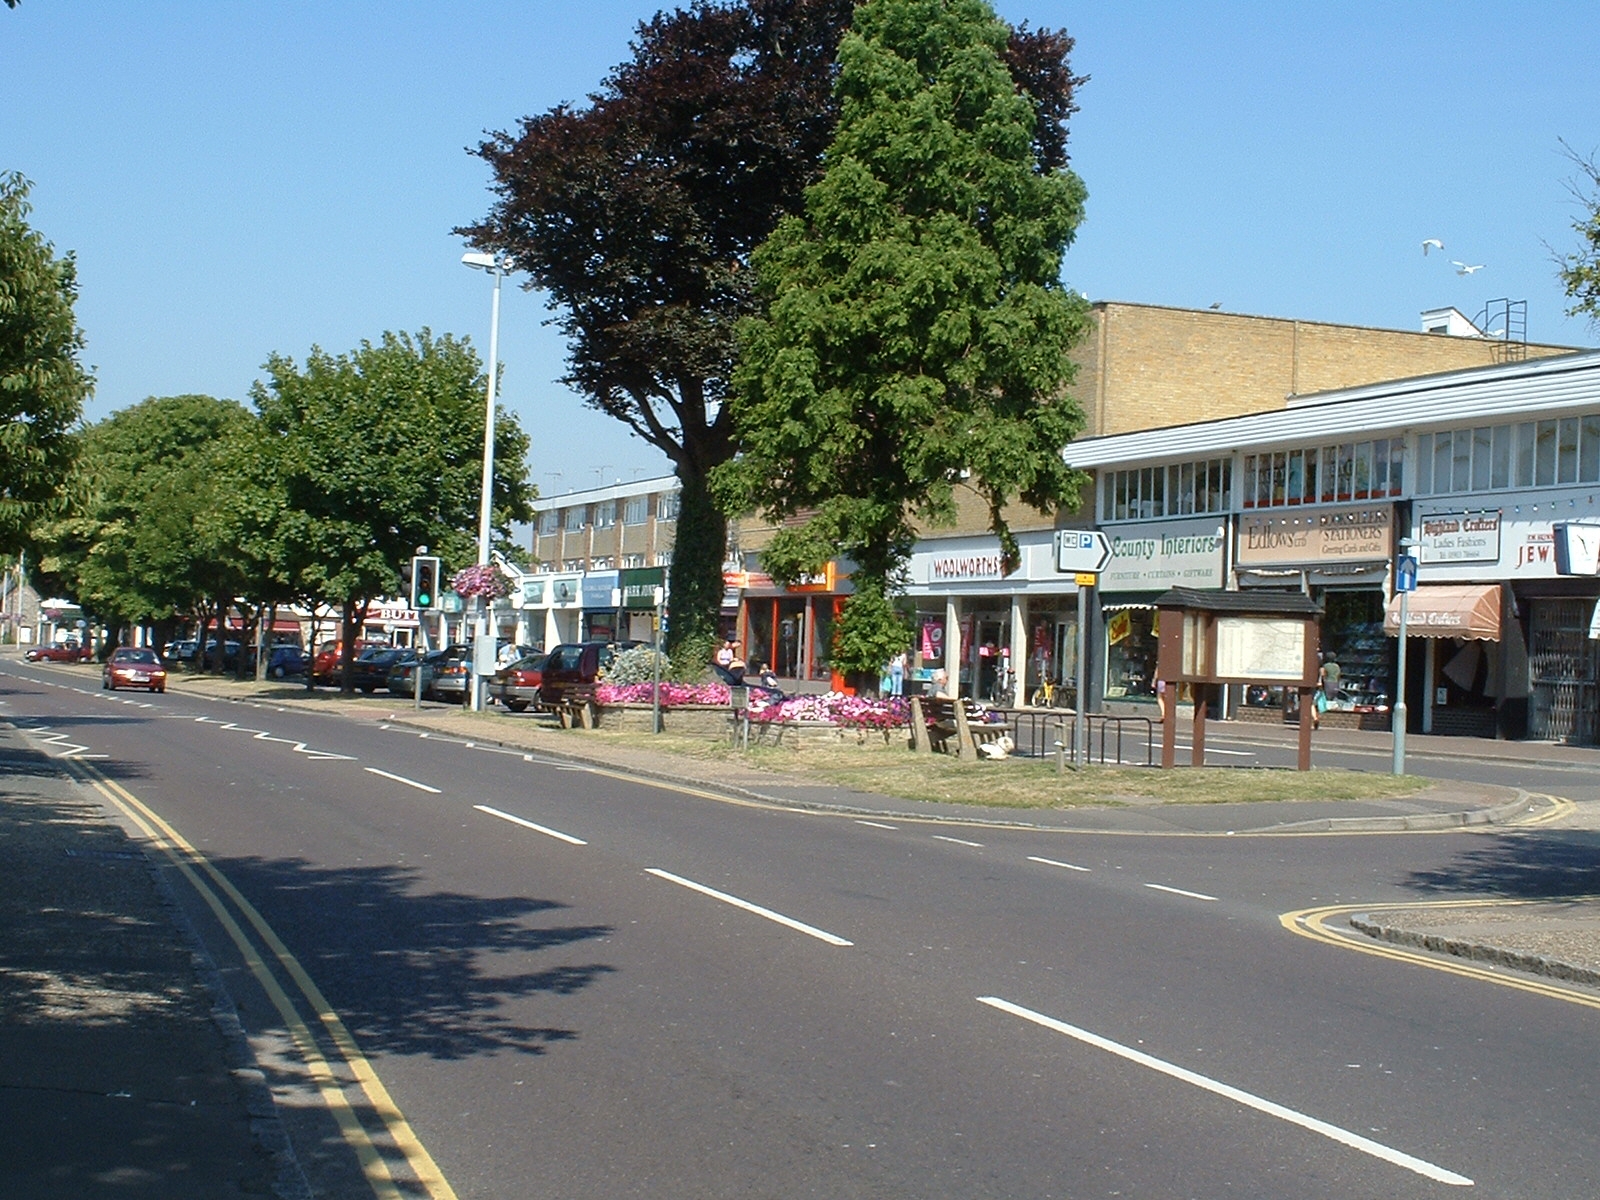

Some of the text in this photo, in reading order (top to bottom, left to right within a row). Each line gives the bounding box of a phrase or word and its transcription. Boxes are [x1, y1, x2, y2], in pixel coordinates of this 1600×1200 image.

[1322, 526, 1382, 541] STATIONERS
[1113, 533, 1214, 559] County Interiors
[934, 556, 998, 577] WOOLWORTHS
[1515, 546, 1556, 569] JEW
